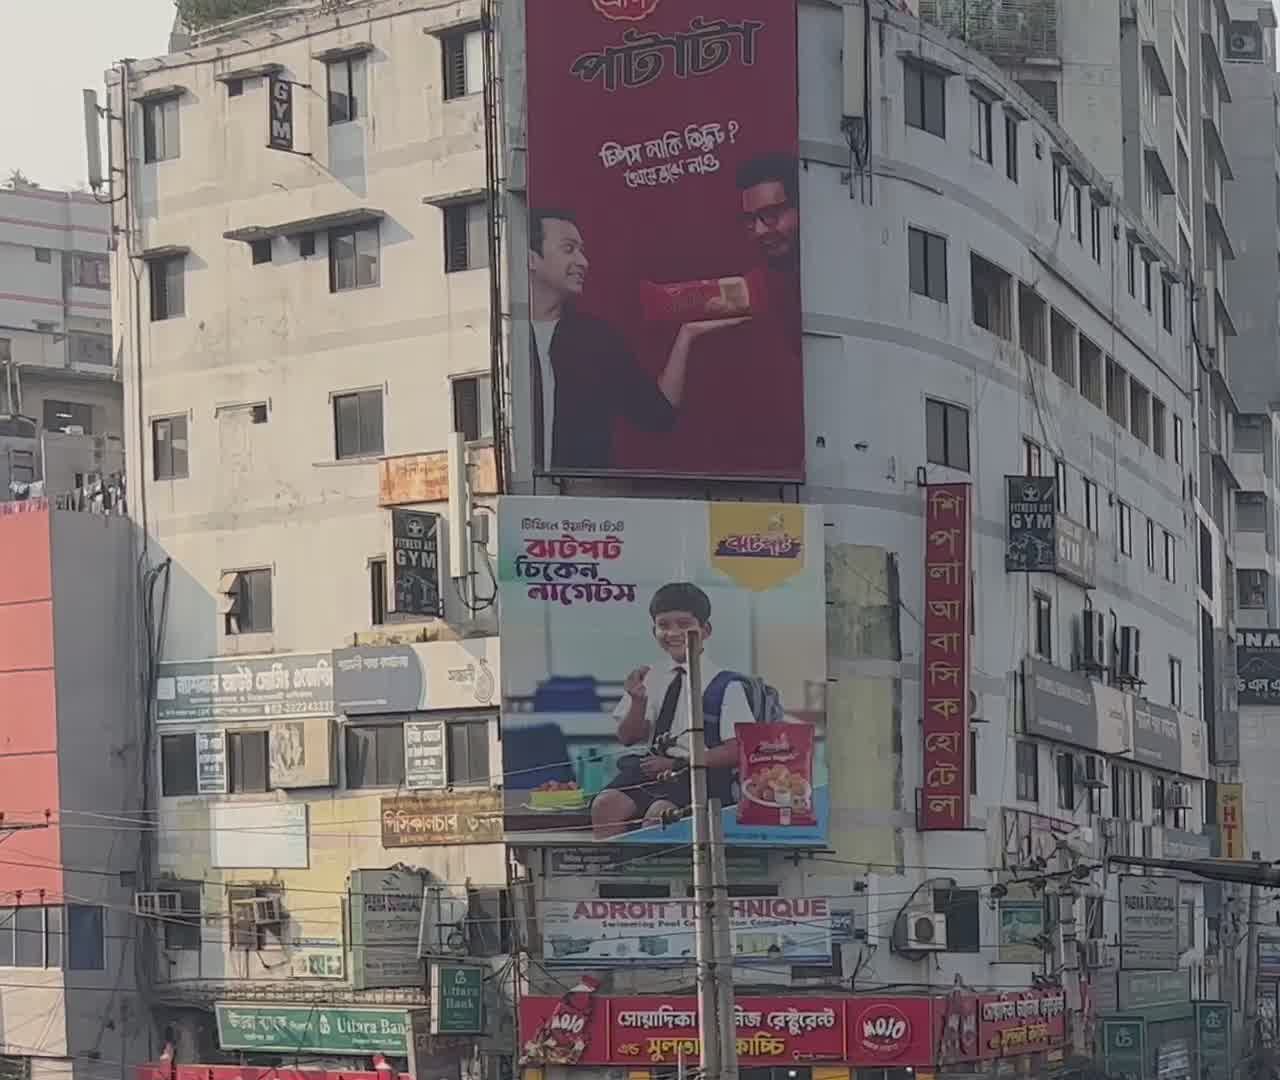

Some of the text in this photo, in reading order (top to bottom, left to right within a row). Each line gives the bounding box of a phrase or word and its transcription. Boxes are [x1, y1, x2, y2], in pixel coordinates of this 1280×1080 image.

[273, 82, 290, 138] GYM
[1011, 513, 1053, 529] GYM
[523, 534, 625, 559] ঝটপট
[395, 550, 436, 568] GYM
[514, 555, 600, 581] চিকেন
[525, 578, 637, 605] নাগেটস
[926, 598, 961, 722] আবাসিক
[925, 732, 960, 818] হোটেল
[572, 898, 828, 921] ADROIT THNIQUE
[443, 983, 479, 997] Uttara
[446, 998, 475, 1009] Bank
[337, 1016, 377, 1034] Uttara
[862, 1016, 907, 1040] MOJO
